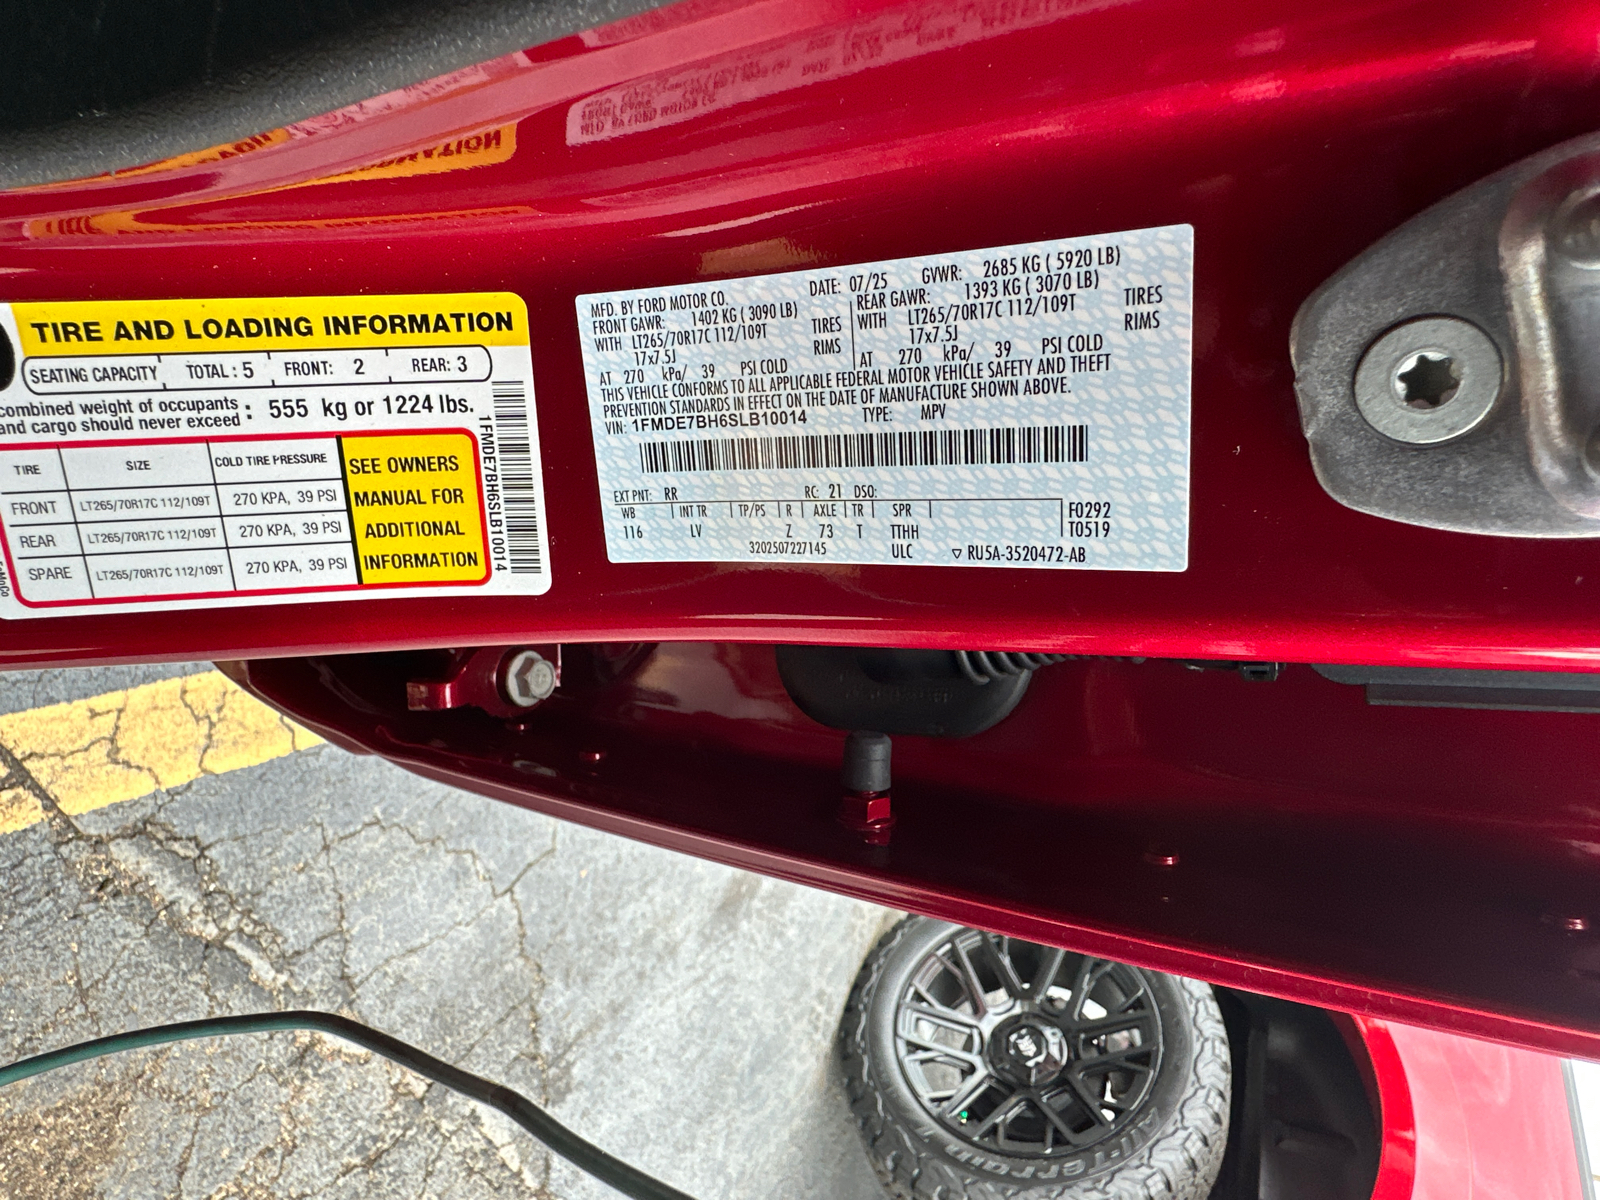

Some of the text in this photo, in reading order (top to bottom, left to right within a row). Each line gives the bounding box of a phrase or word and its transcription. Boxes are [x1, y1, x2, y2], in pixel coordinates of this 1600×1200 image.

[921, 245, 1121, 285] GVWR: 2685 KG 5920 LB)
[809, 272, 888, 297] DATE: 07/25
[856, 269, 1099, 311] REAR GAWR: 1393 KG 3070 LB)
[591, 290, 729, 318] MFD. BY FORD MOTOR CO.
[856, 284, 1163, 330] WITH LT265/70R17C 112/109T TIRES
[30, 311, 513, 343] TIRE AND LOADING INFORMATION
[592, 301, 798, 335] FRONT GAWR: 1402 KG 3090 LB)
[909, 309, 1160, 345] 17x7.5J RIMS
[594, 315, 842, 352] WITH LT265/70R17C 112/109T TIRES
[634, 337, 842, 366] 17x7.5J RIMS
[859, 333, 1103, 368] AT 270 kPa/ 39 PSI COLD
[29, 367, 89, 384] SEATING
[92, 365, 157, 383] CAPACITY
[242, 361, 254, 379] 5
[284, 360, 334, 377] FRONT:
[353, 358, 365, 375] 2
[411, 357, 451, 373] REAR:
[457, 355, 468, 373] 3
[600, 357, 788, 386] AT 270 kPa/ 39 PSI COLD
[600, 353, 1112, 402] THIS VEHICLE CONFORMS TO ALL APPLICABLE FEDERAL MOTOR VEHICLE SAFETY AND THEFT
[0, 396, 239, 418] combined weight of occupants
[268, 394, 474, 420] 555 kg or 1224 lbs.
[603, 376, 1071, 419] PREVENTION STANDARDS IN EFFECT ON THE DATE OF MANUFACTURE SHOWN ABOVE.
[604, 409, 808, 435] VIN: 1FMDE7BH6SLB10014
[861, 403, 947, 423] TYPE: MPV
[0, 419, 27, 435] and
[31, 421, 77, 436] cargo
[81, 416, 134, 432] should
[138, 417, 182, 430] never
[13, 464, 41, 475] TIRE
[125, 460, 151, 471] SIZE
[214, 453, 328, 468] COLD TIRE PRESSURE
[349, 455, 459, 475] SEE OWNERS
[233, 489, 337, 506] 270 KPA, 39 PSI
[353, 488, 464, 507] MANUAL FOR
[478, 415, 508, 572] 1FMDE7BH6SLB10014
[613, 489, 630, 503] EXT
[663, 487, 679, 501] RR
[828, 483, 842, 499] 21
[11, 500, 56, 515] FRONT
[81, 495, 210, 512] LT265/70R17C 112/109T
[621, 506, 636, 519] WB
[679, 504, 708, 518] INT TR
[738, 504, 766, 518] TP/PS
[813, 503, 837, 517] AXLE
[892, 503, 912, 517] SPR
[88, 528, 216, 544] LT265/70R17C 112/109T
[239, 521, 342, 538] 270 KPA, 39 PSI
[365, 520, 465, 539] ADDITIONAL
[623, 525, 643, 539] 116
[819, 523, 834, 539] 73
[19, 534, 57, 548] REAR
[363, 551, 478, 570] INFORMATION
[891, 543, 913, 559] ULC
[28, 566, 73, 581] SPARE
[97, 564, 223, 581] LT265/70R17C 112/109T
